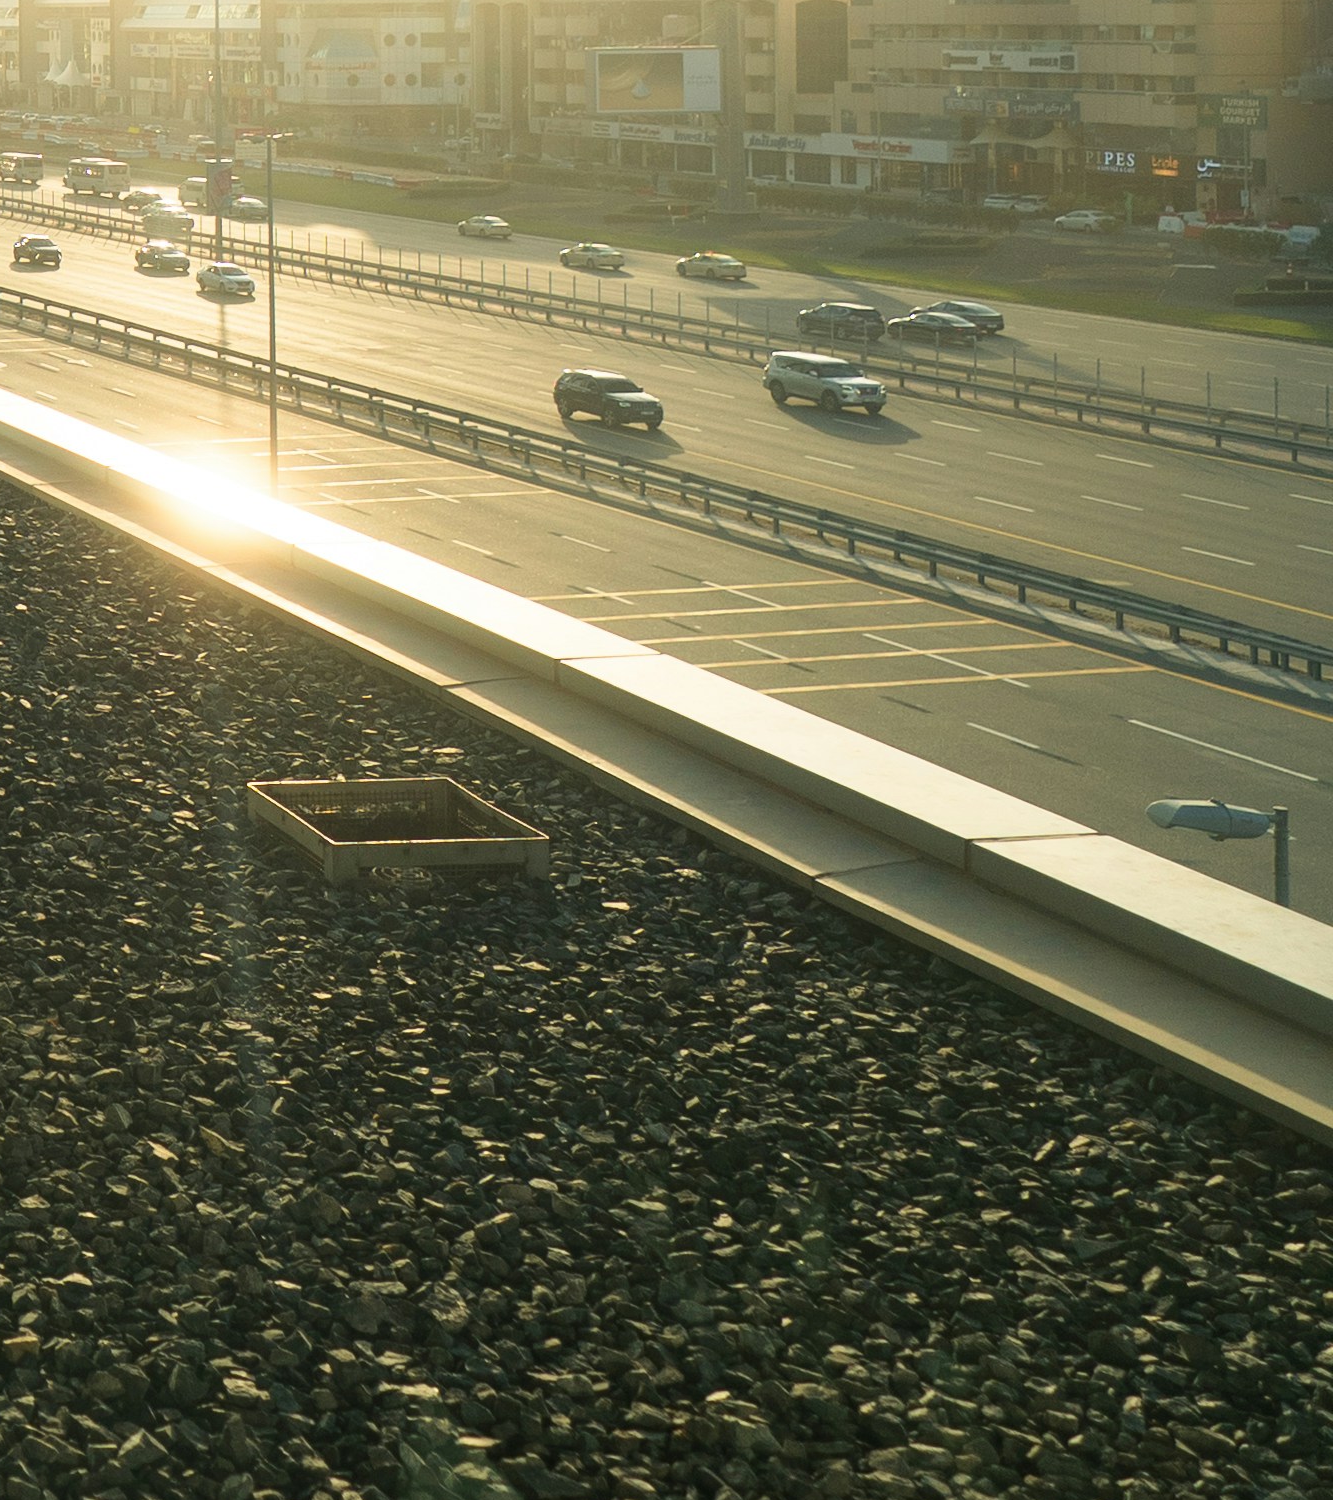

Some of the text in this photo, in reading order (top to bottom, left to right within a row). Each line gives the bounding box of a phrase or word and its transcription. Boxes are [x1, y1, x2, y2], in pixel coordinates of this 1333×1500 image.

[1222, 98, 1259, 107] TURKISH
[1222, 115, 1258, 126] MARKET
[1085, 150, 1135, 167] PIPES
